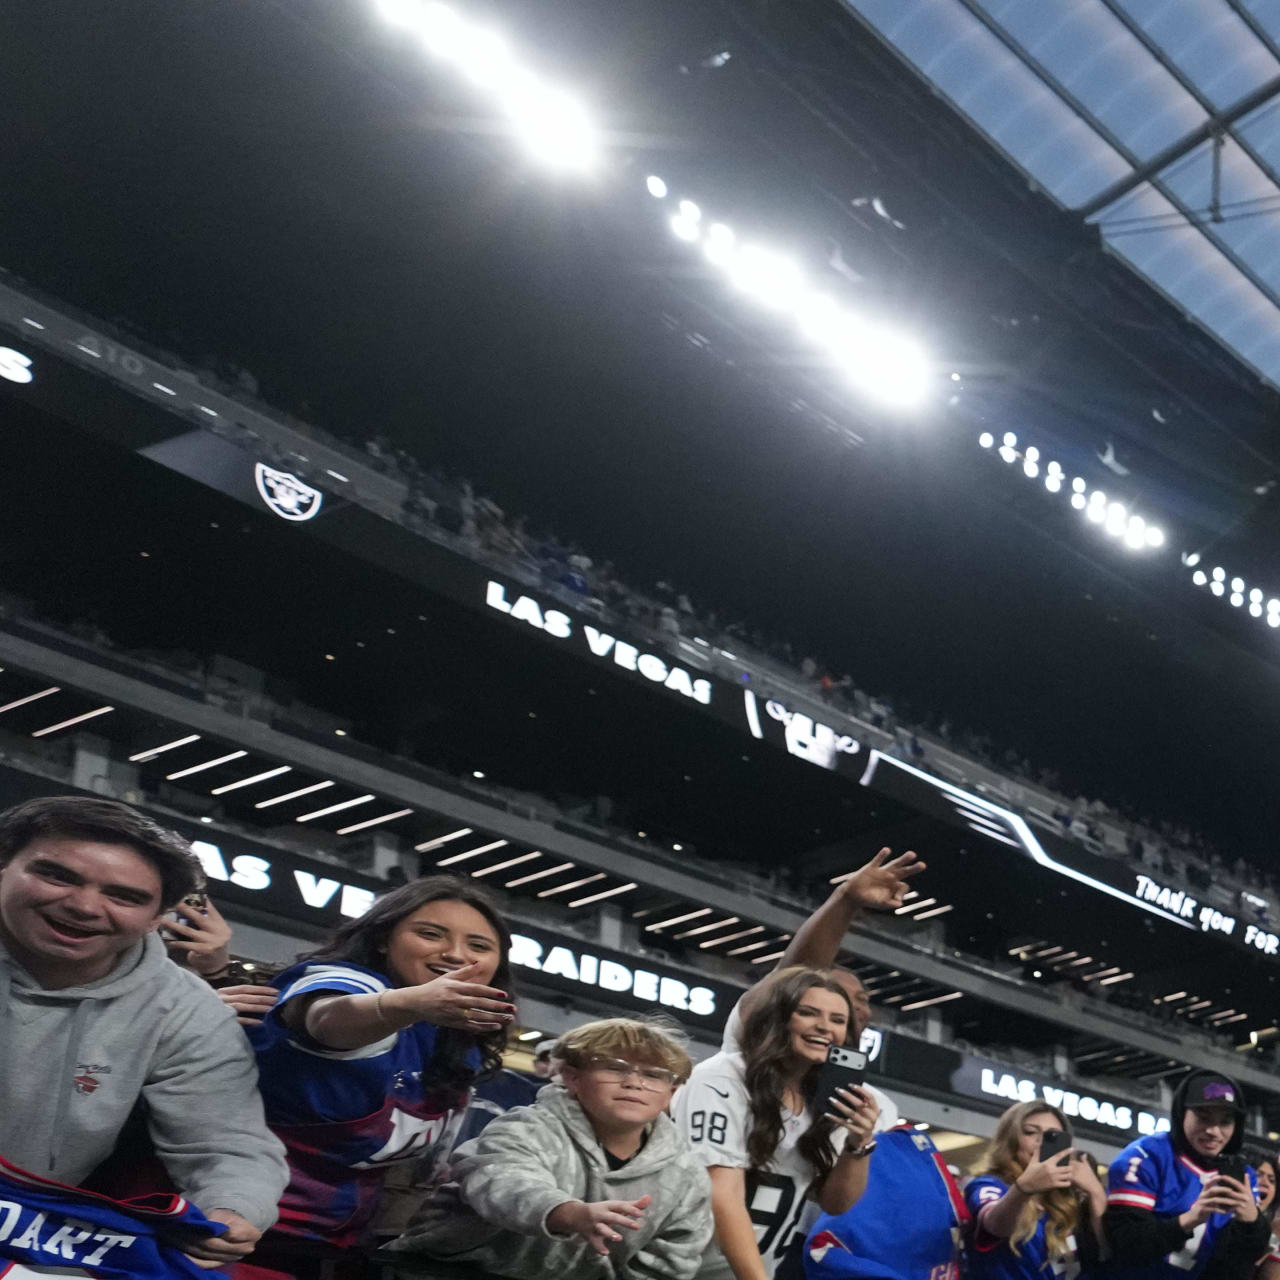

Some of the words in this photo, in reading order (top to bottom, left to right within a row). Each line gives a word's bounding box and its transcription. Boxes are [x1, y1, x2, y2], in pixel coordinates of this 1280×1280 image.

[486, 580, 571, 638] LAS
[584, 625, 711, 705] VEGAS
[190, 840, 272, 890] AS
[1136, 874, 1198, 919] THANK
[1244, 924, 1280, 955] FOR
[508, 933, 716, 1016] RAIDERS
[690, 1110, 728, 1145] 98
[980, 1068, 1036, 1103] LAS
[1042, 1085, 1133, 1129] VEGAS
